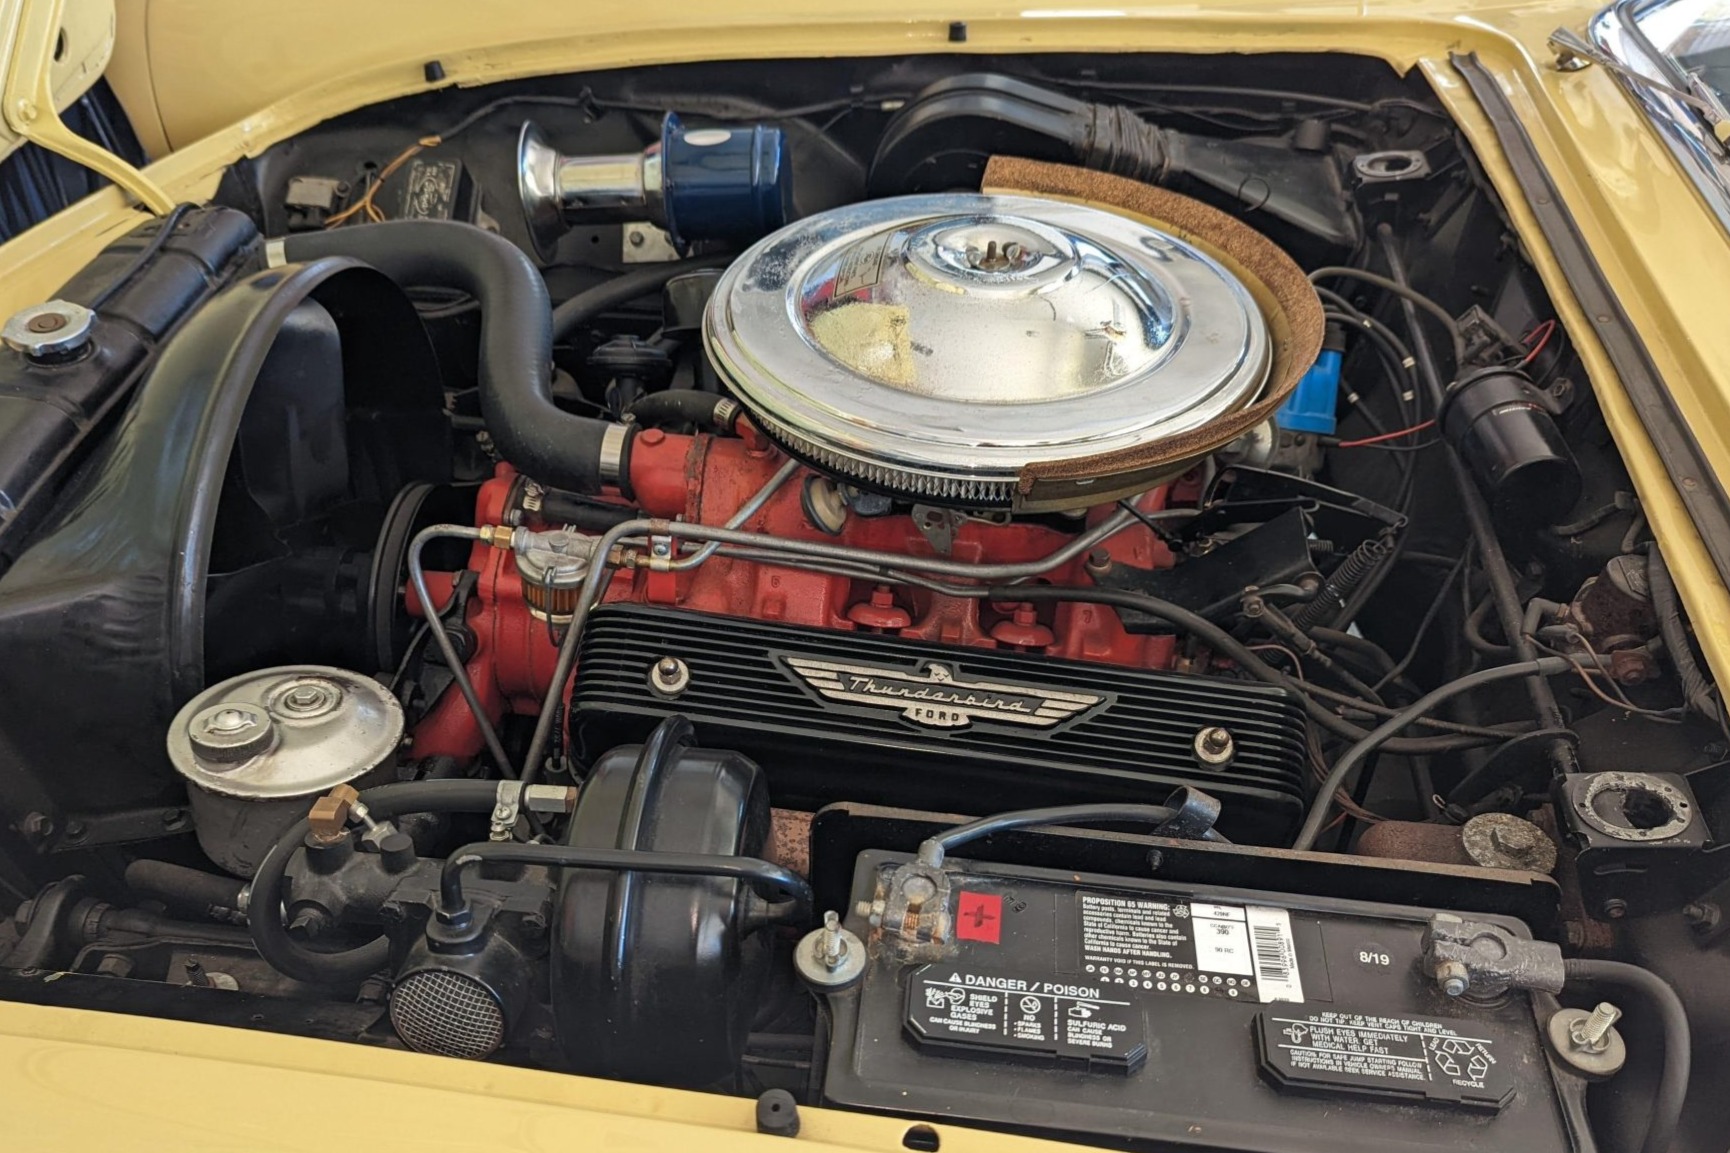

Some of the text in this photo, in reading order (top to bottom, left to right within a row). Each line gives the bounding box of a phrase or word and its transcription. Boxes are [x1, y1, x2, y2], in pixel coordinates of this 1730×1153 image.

[849, 676, 1031, 713] Thunderbird
[915, 708, 959, 722] FORD
[1083, 896, 1126, 907] PROPOSITION
[1127, 900, 1136, 908] 65
[1083, 903, 1100, 911] Battery
[1104, 922, 1128, 930] California
[1115, 918, 1140, 926] chemicals
[1084, 927, 1115, 935] reproductive
[1132, 930, 1155, 938] Batteries
[1098, 934, 1124, 942] chemicals
[1084, 938, 1109, 946] California
[1102, 946, 1121, 954] HANDS
[1123, 948, 1141, 956] AFTER
[1360, 951, 1390, 965] 8/19
[965, 974, 1100, 998] DANGER / POISON
[969, 993, 998, 1003] SHIELD
[950, 1004, 993, 1016] EXPLOSIVE
[969, 1000, 990, 1009] EYES
[949, 1011, 977, 1021] GASES
[1023, 1014, 1036, 1022] NO
[929, 1016, 996, 1030] CAN CAUSE BLINDNESS
[1067, 1019, 1127, 1032] SULFURIC ACID
[1412, 1020, 1443, 1029] CHILDREN
[958, 1026, 980, 1034] INJURY
[1082, 1028, 1103, 1036] CAUSE
[1310, 1026, 1408, 1043] FLUSH EYES IMMEDIATELY
[1067, 1032, 1100, 1041] BLINDNESS
[1311, 1033, 1330, 1041] WITH
[1363, 1038, 1378, 1046] GET
[1067, 1038, 1113, 1049] SEVERE BURNS
[1312, 1040, 1388, 1055] MEDICAL HELP FAST
[1428, 1037, 1440, 1051] LEAD
[1475, 1043, 1497, 1064] RETURN
[1291, 1055, 1334, 1065] INSTRUCTIONS
[1367, 1057, 1397, 1065] STARTING
[1398, 1060, 1422, 1068] FOLLOW
[1312, 1064, 1343, 1073] AVAILABLE
[1344, 1066, 1360, 1074] SEEK
[1361, 1068, 1386, 1077] SERVICE
[1452, 1079, 1485, 1089] RECYCLE
